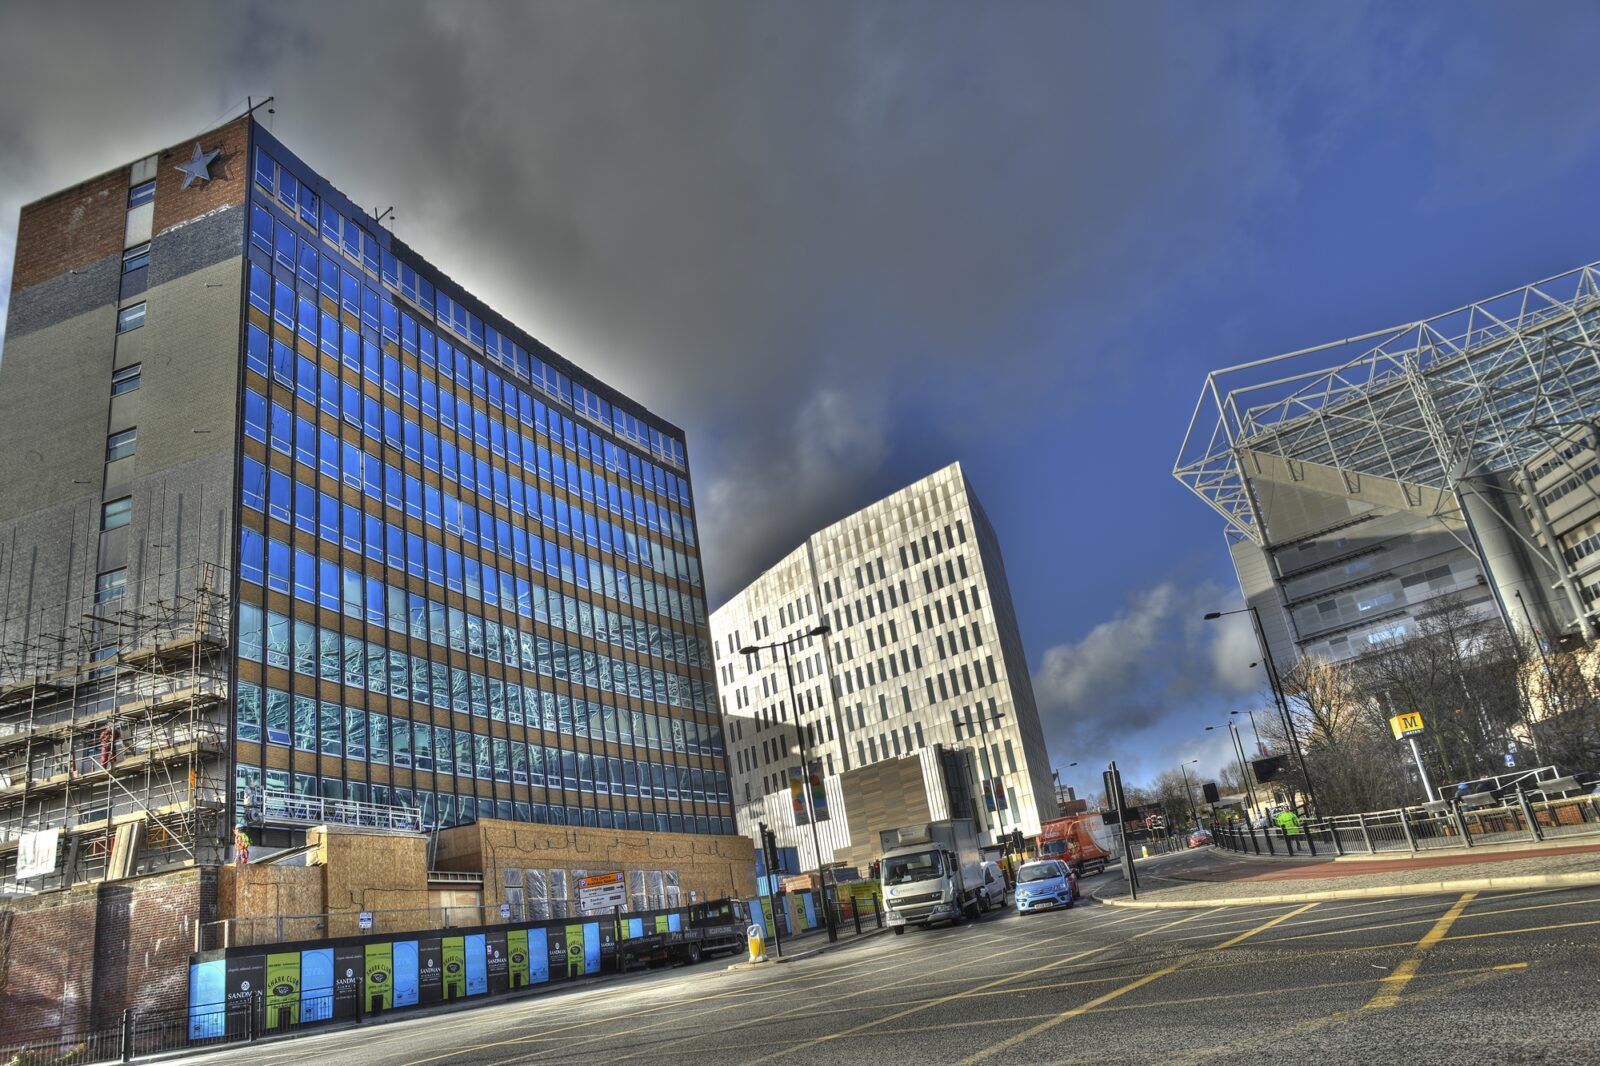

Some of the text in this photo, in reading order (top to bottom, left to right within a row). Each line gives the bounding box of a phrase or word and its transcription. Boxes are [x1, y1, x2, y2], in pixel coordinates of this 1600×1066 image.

[1402, 716, 1418, 728] M
[488, 957, 507, 965] SANDMAN
[366, 964, 392, 976] SHARK CLUB
[268, 975, 299, 990] SHARK CLUB
[227, 989, 263, 1000] SANDMN
